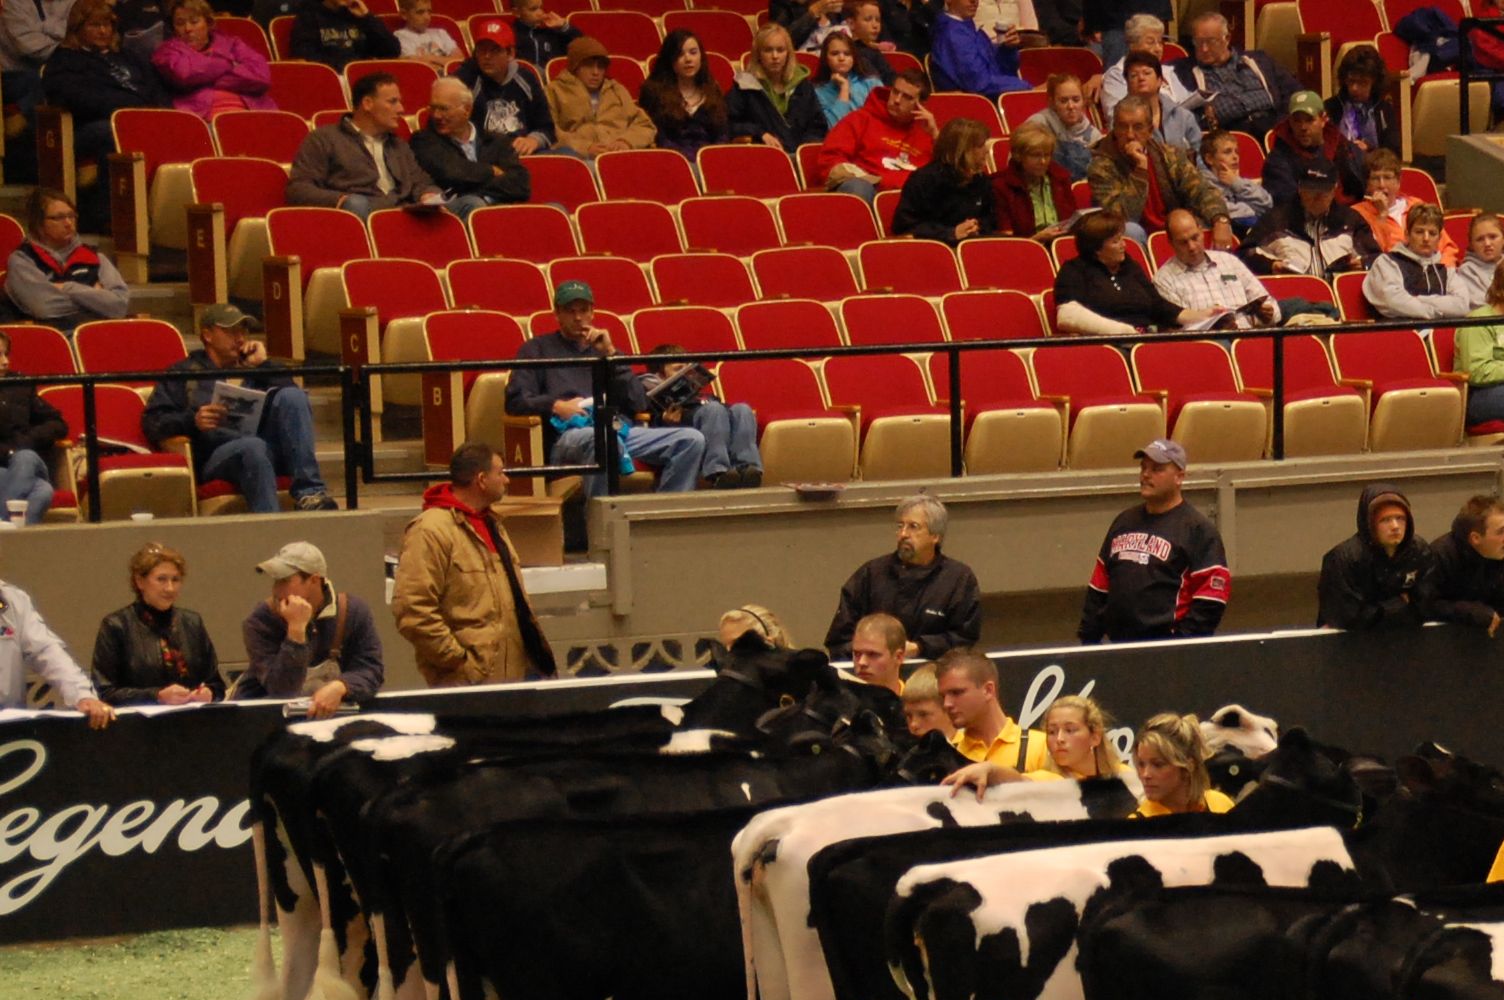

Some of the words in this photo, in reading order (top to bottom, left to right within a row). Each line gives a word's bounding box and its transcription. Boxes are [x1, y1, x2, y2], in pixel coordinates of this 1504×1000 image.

[46, 129, 55, 148] G
[197, 229, 205, 248] E
[273, 281, 281, 300] D
[350, 333, 359, 353] C
[433, 387, 442, 406] B
[514, 443, 523, 463] A
[1110, 532, 1172, 562] MARYLAND
